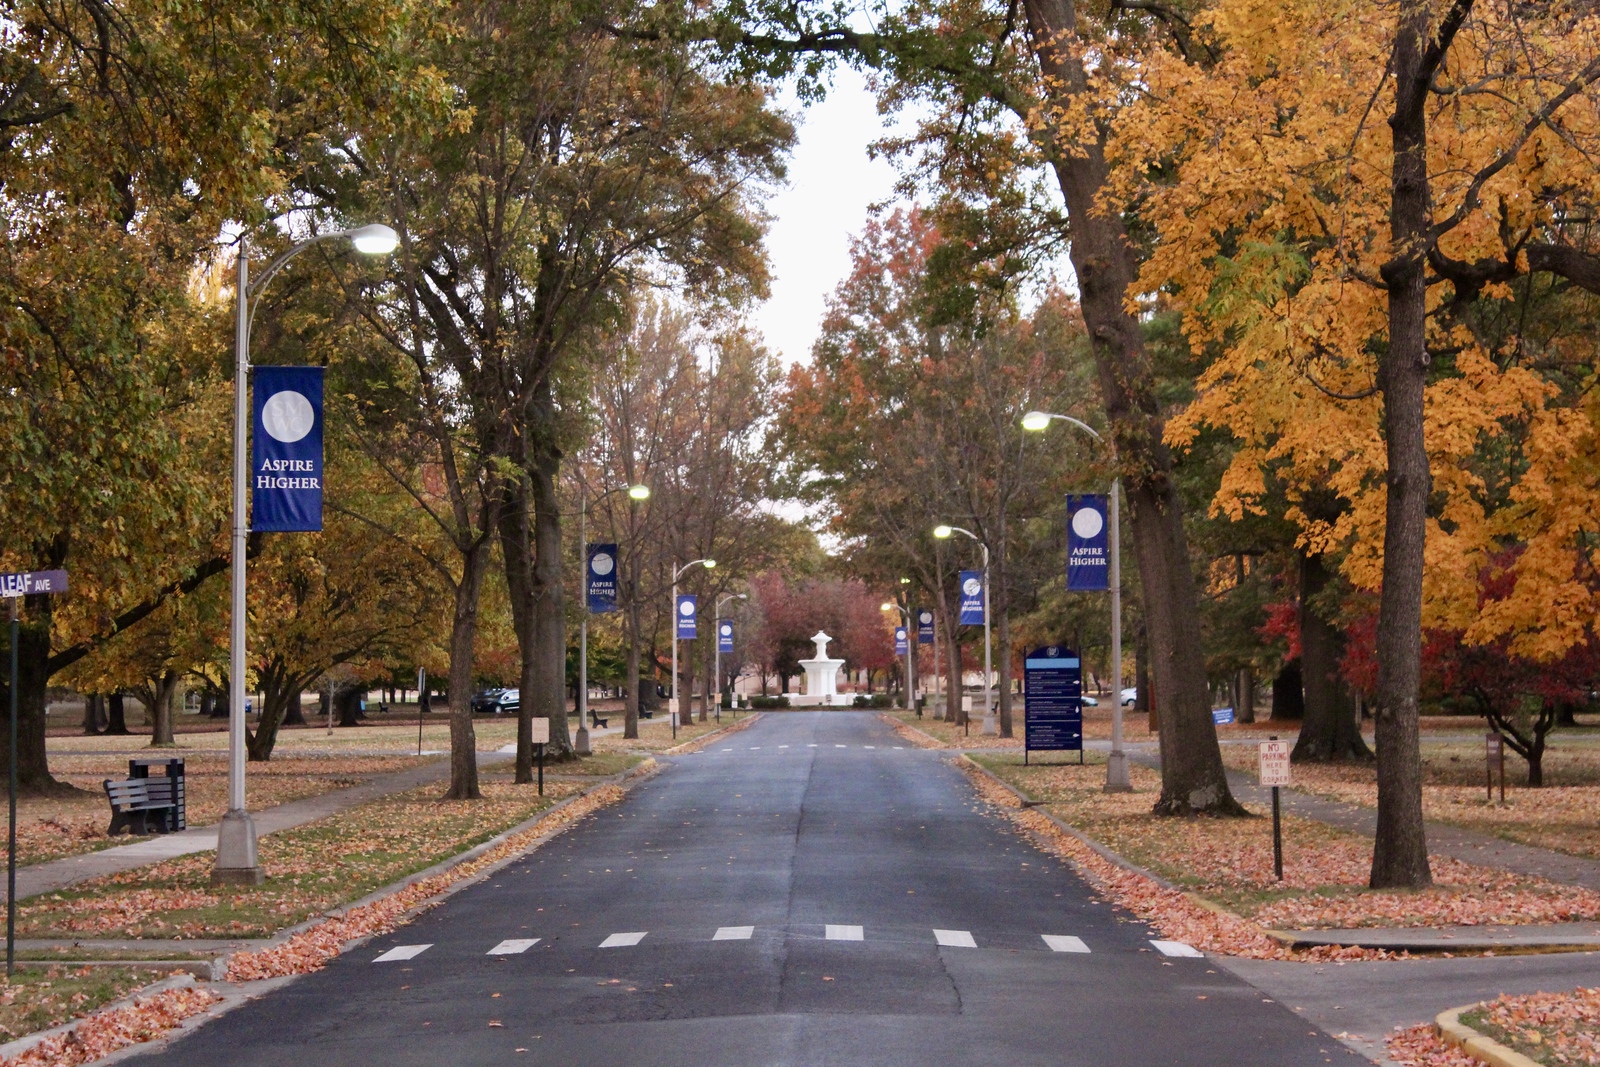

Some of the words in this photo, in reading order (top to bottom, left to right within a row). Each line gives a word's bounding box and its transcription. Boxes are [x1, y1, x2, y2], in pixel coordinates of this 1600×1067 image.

[261, 458, 314, 471] ASPIRE
[257, 476, 320, 489] HIGHER
[1072, 547, 1103, 555] ASPIRE
[1070, 557, 1106, 565] HIGHER
[0, 574, 31, 595] LEAF
[35, 579, 51, 591] AVE
[1268, 744, 1279, 752] NO
